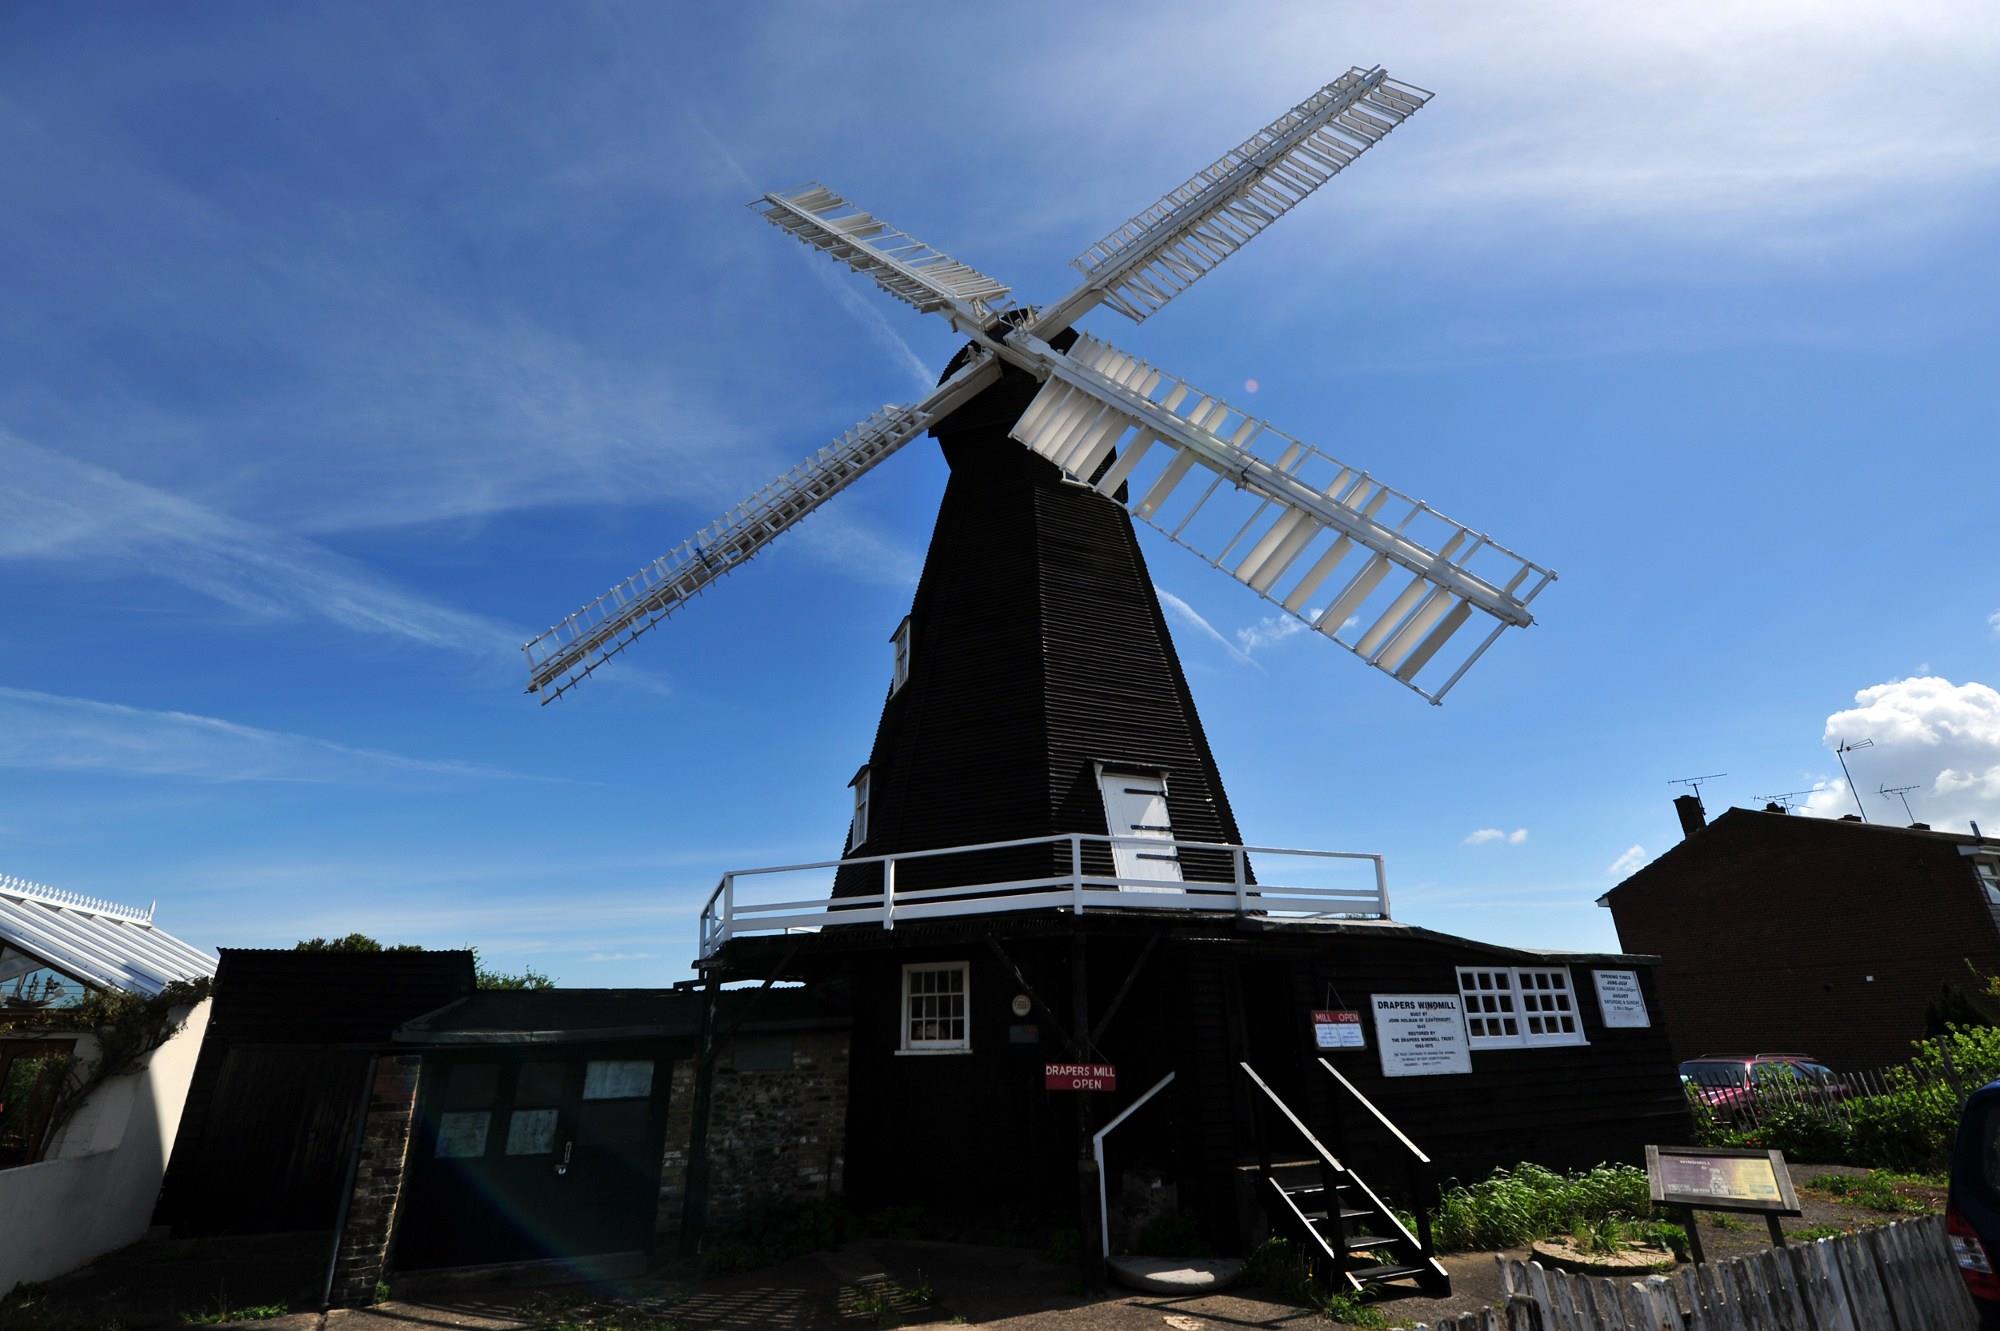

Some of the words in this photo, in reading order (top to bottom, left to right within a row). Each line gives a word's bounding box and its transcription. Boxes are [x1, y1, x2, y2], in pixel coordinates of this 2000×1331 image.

[1377, 1001, 1415, 1009] DRAPERS
[1417, 1001, 1456, 1009] WINDMILL
[1315, 1013, 1332, 1022] MILL
[1338, 1013, 1359, 1022] OPEN
[1045, 1064, 1090, 1076] DRAPERS
[1093, 1066, 1116, 1077] MILL
[1072, 1079, 1102, 1089] OPEN
